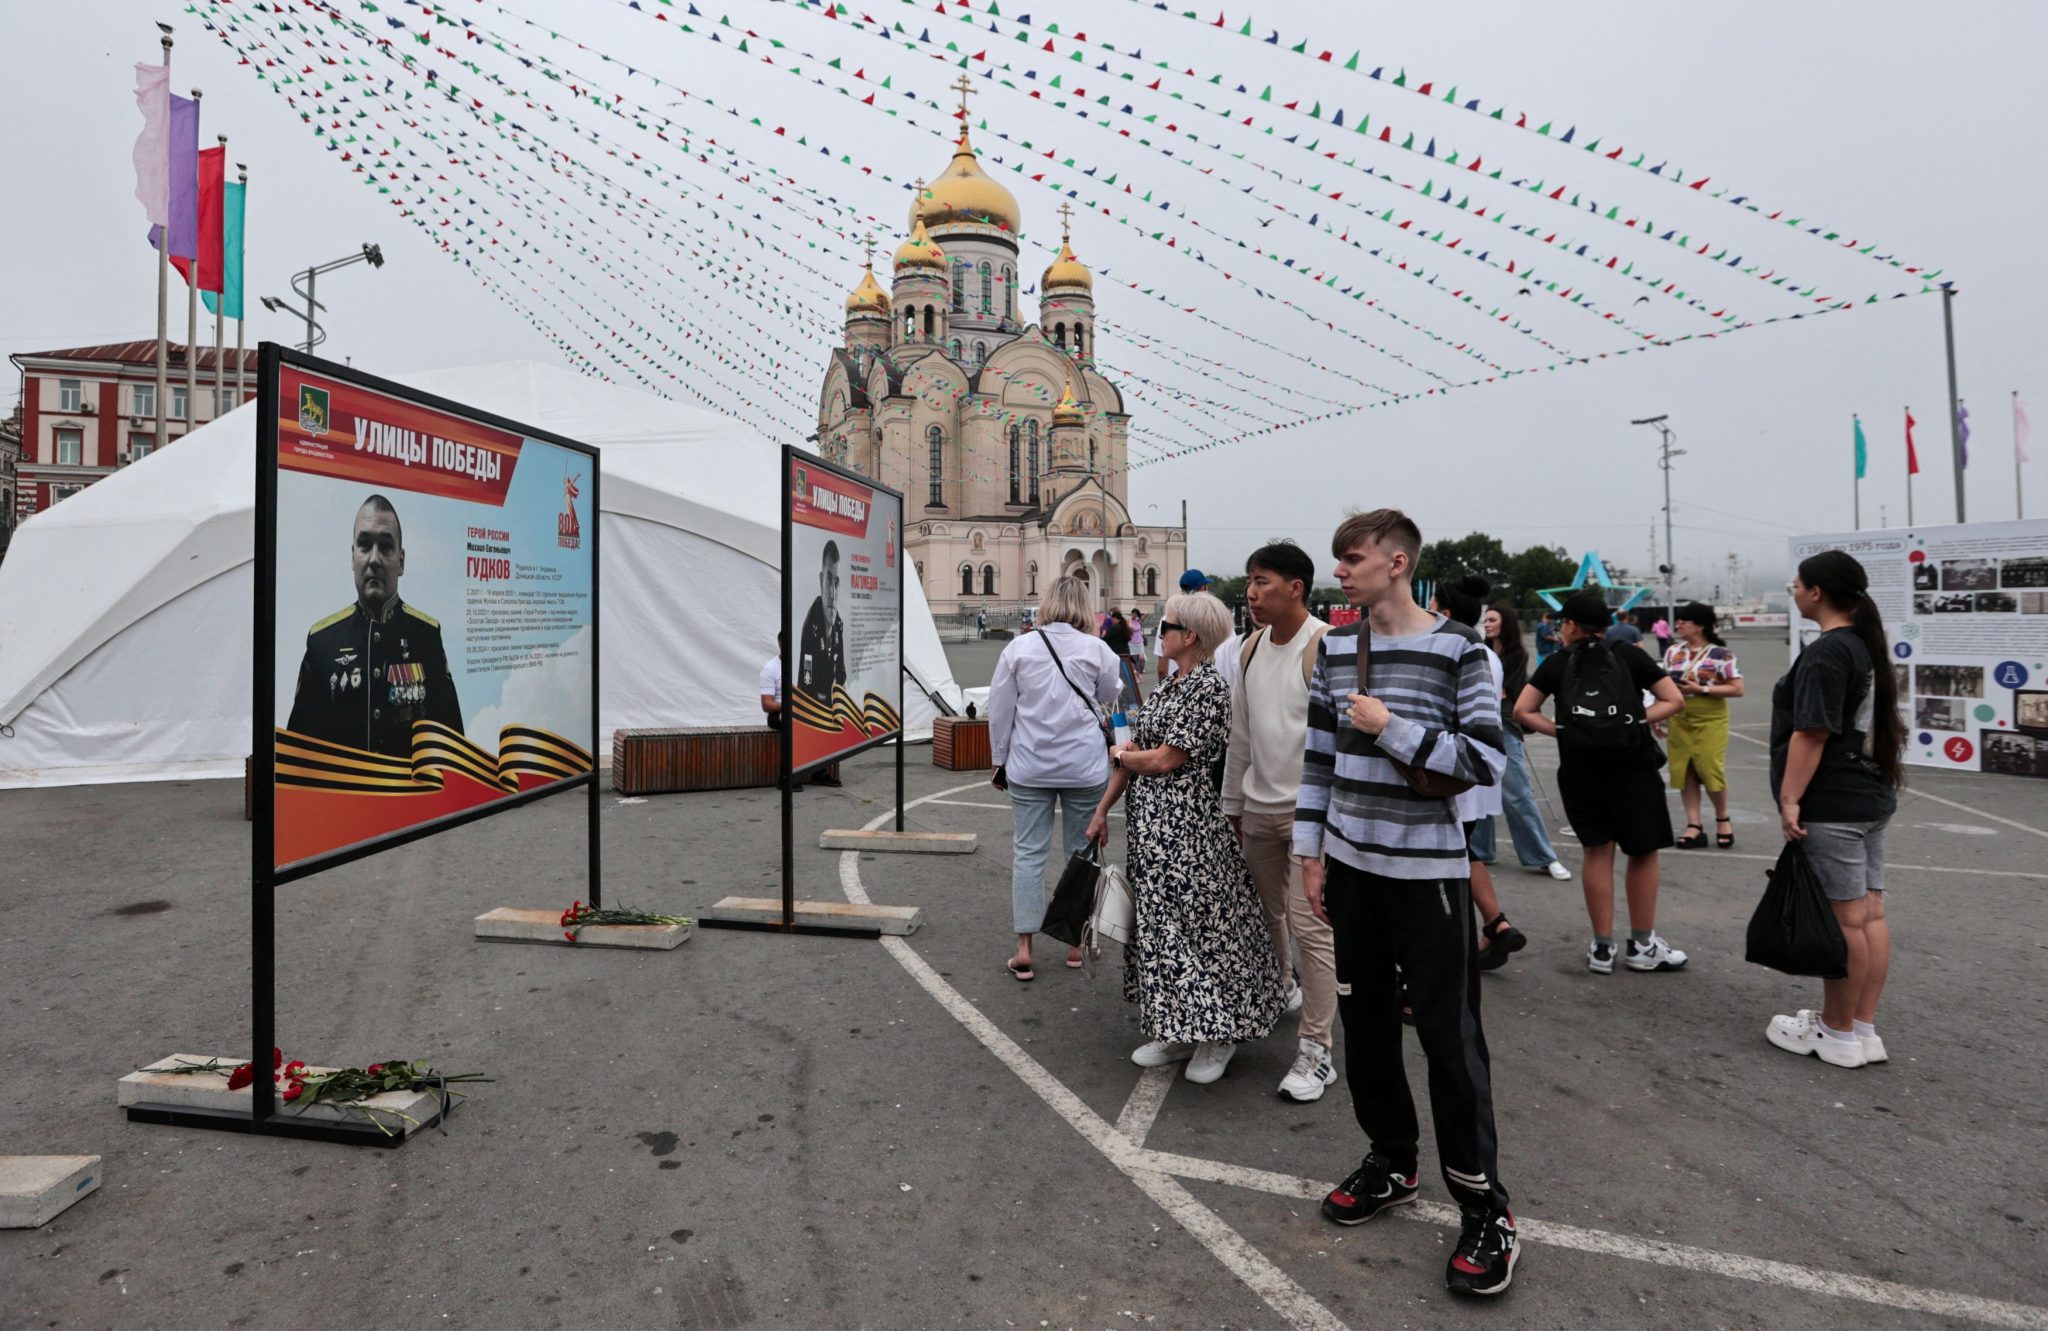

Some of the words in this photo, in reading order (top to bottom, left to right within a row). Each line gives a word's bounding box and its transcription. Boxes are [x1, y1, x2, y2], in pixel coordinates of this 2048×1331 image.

[354, 416, 427, 466] УЛИЦЫ
[432, 437, 501, 482] ПОБЕДЫ
[812, 485, 838, 515] УЛИЦЫ
[838, 494, 865, 523] ПОБЕДЫ
[467, 527, 486, 539] ГЕРОЙ
[487, 529, 510, 542] РОССИИ
[467, 542, 485, 552] Михаил
[486, 544, 511, 554] Евгеньевич
[558, 537, 580, 550] ПОБЕДА!
[1849, 542, 1873, 552] 1975
[1875, 542, 1902, 550] года
[467, 556, 511, 582] ГУДКОВ
